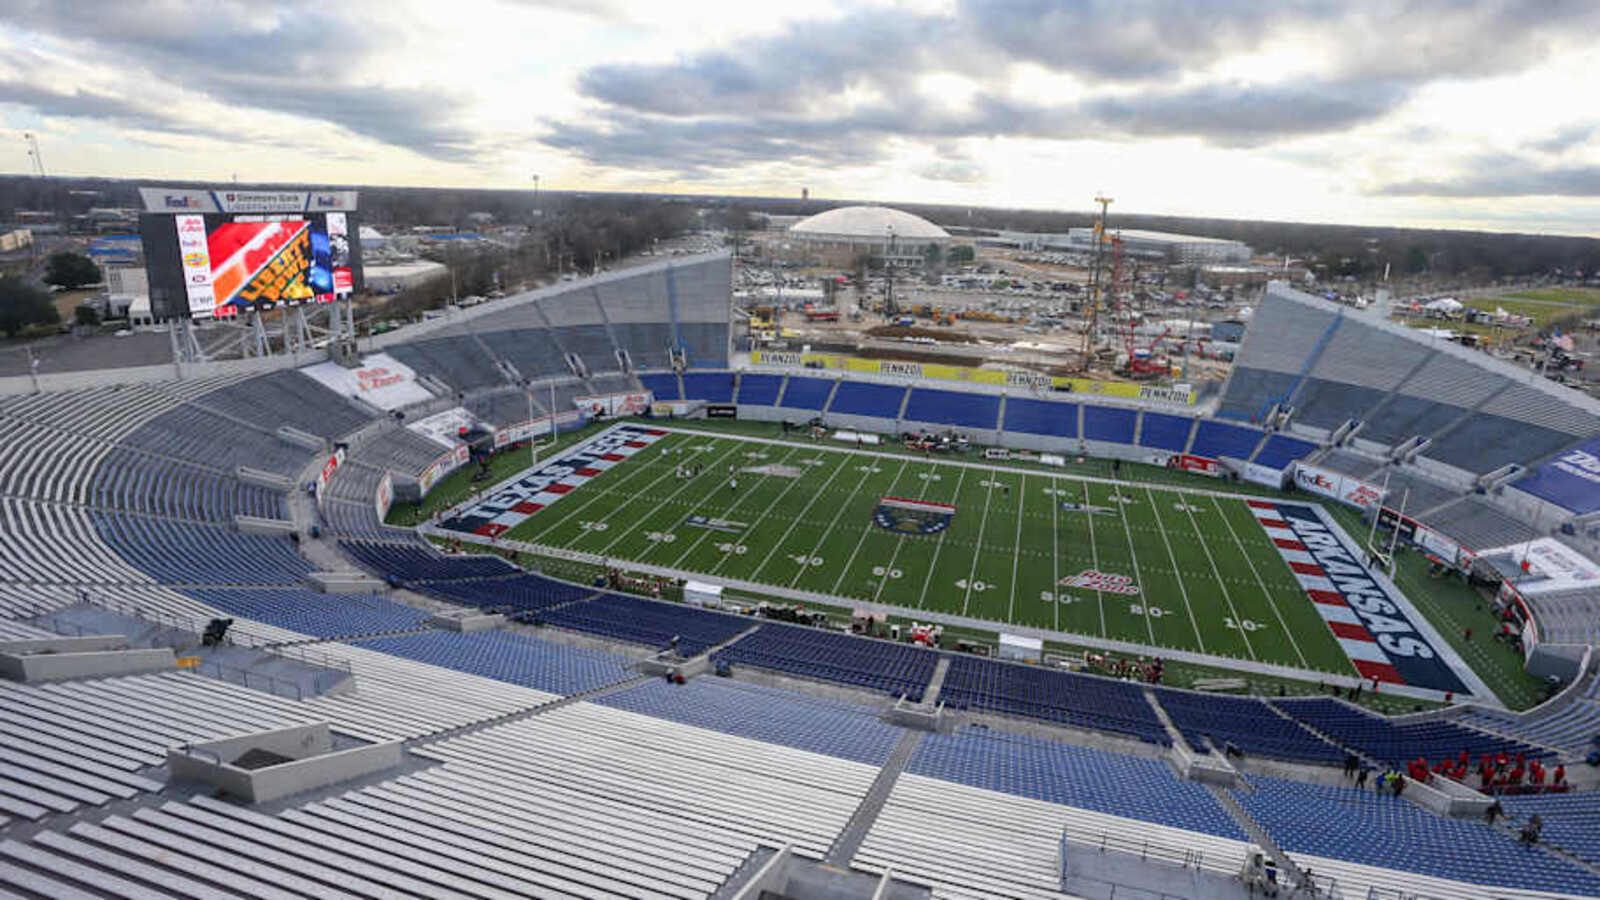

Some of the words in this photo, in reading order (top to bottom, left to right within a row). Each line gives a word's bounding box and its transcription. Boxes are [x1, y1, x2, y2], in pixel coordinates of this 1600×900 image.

[238, 228, 310, 301] LIBERTY
[262, 256, 310, 302] BOWL
[461, 463, 576, 519] TEXAS
[1284, 515, 1434, 660] ARKANSAS
